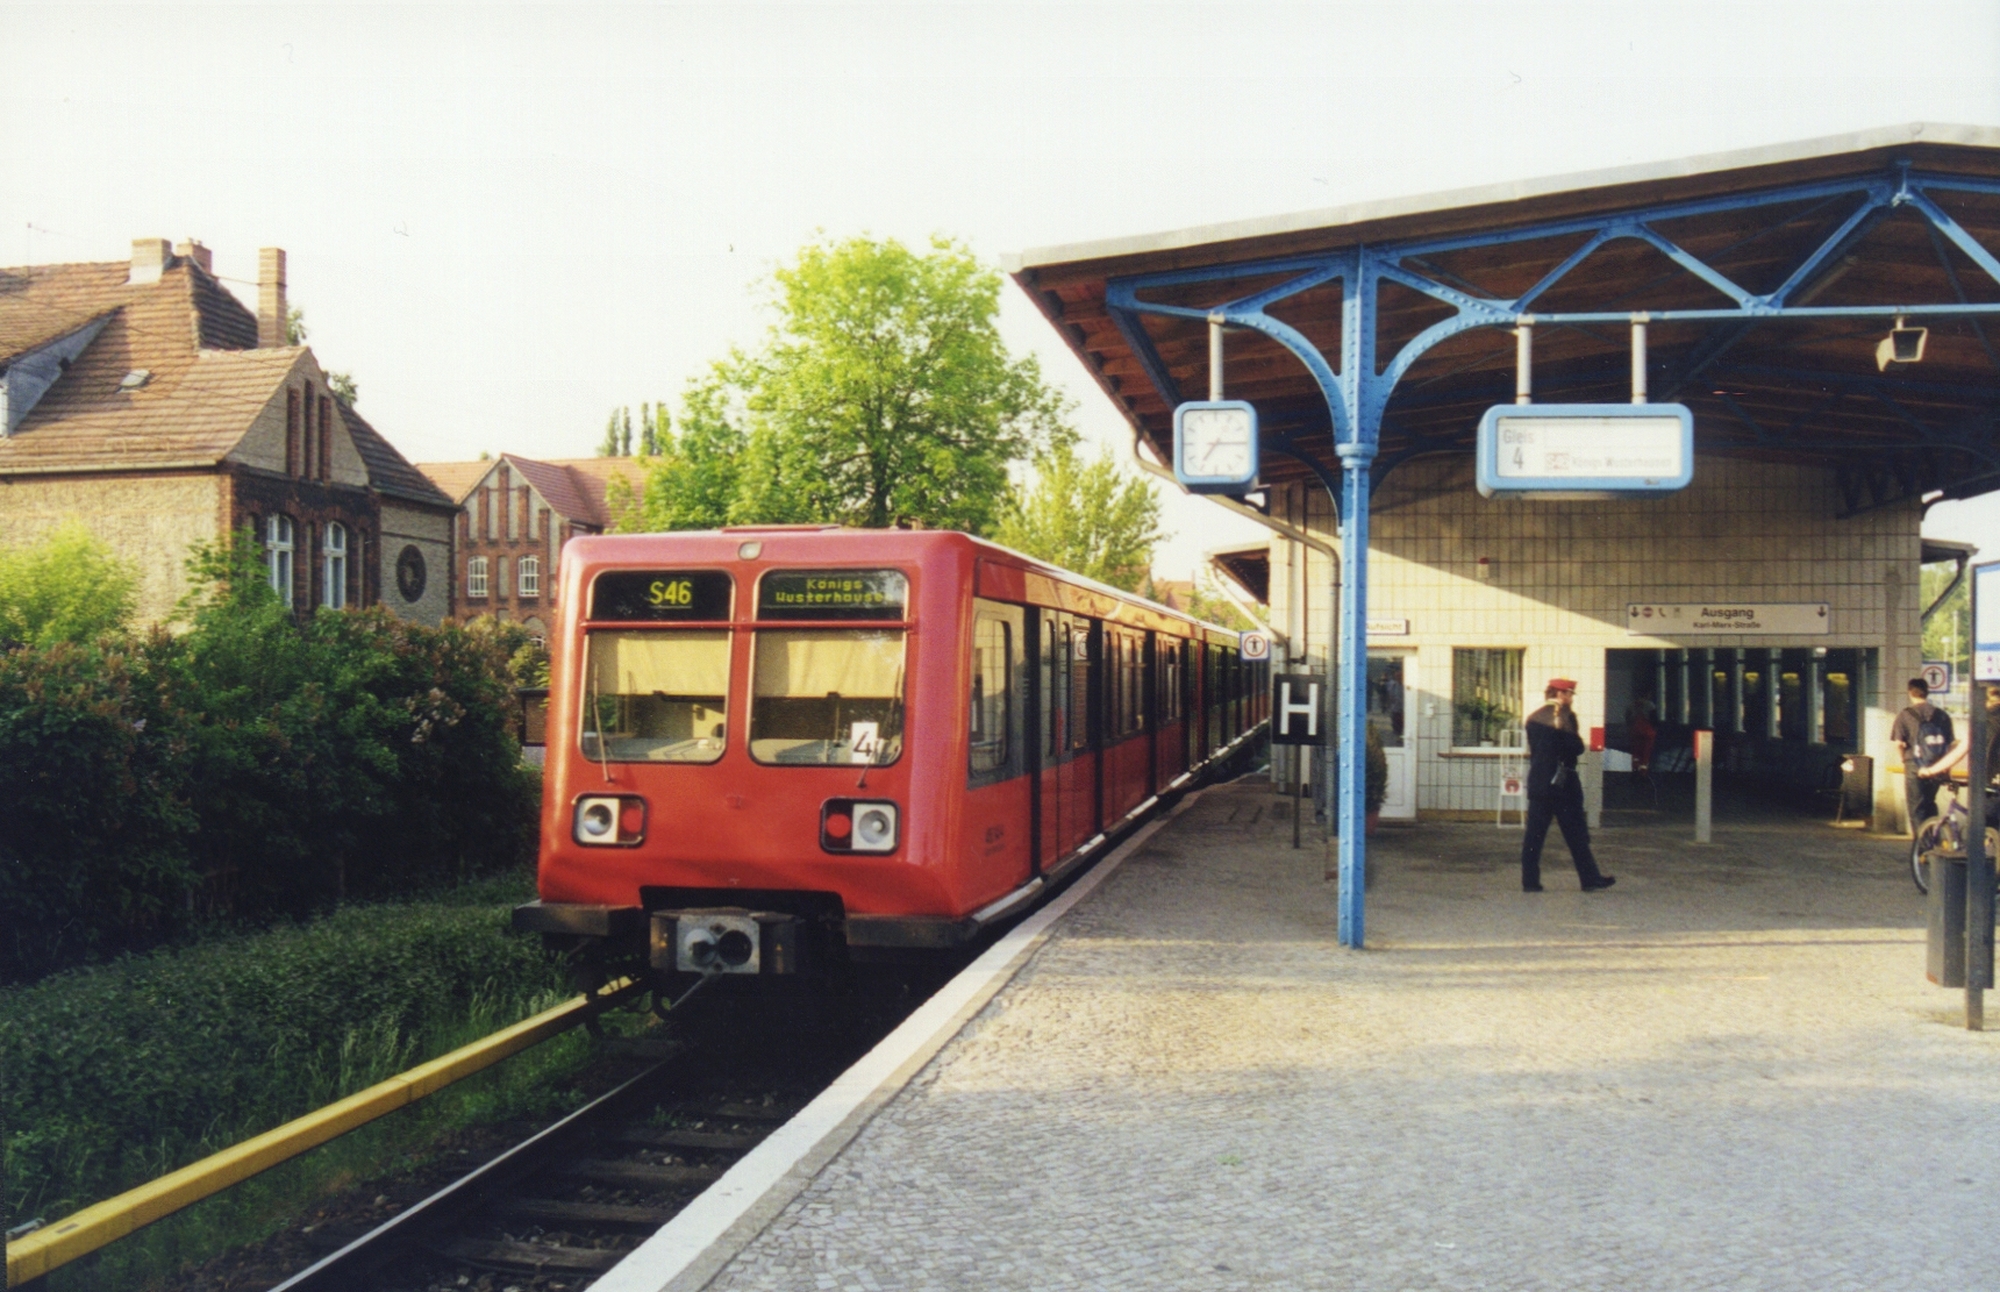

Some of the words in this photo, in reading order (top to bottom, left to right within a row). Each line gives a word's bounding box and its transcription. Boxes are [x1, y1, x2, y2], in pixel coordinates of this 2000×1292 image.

[1503, 429, 1535, 445] Gleis
[1512, 446, 1524, 469] 4
[650, 581, 692, 604] S46
[806, 577, 863, 591] Königs
[1701, 607, 1754, 620] Ausgang
[1693, 620, 1762, 629] Karl-Marx-Straße
[1280, 682, 1318, 735] H
[853, 731, 873, 757] 4
